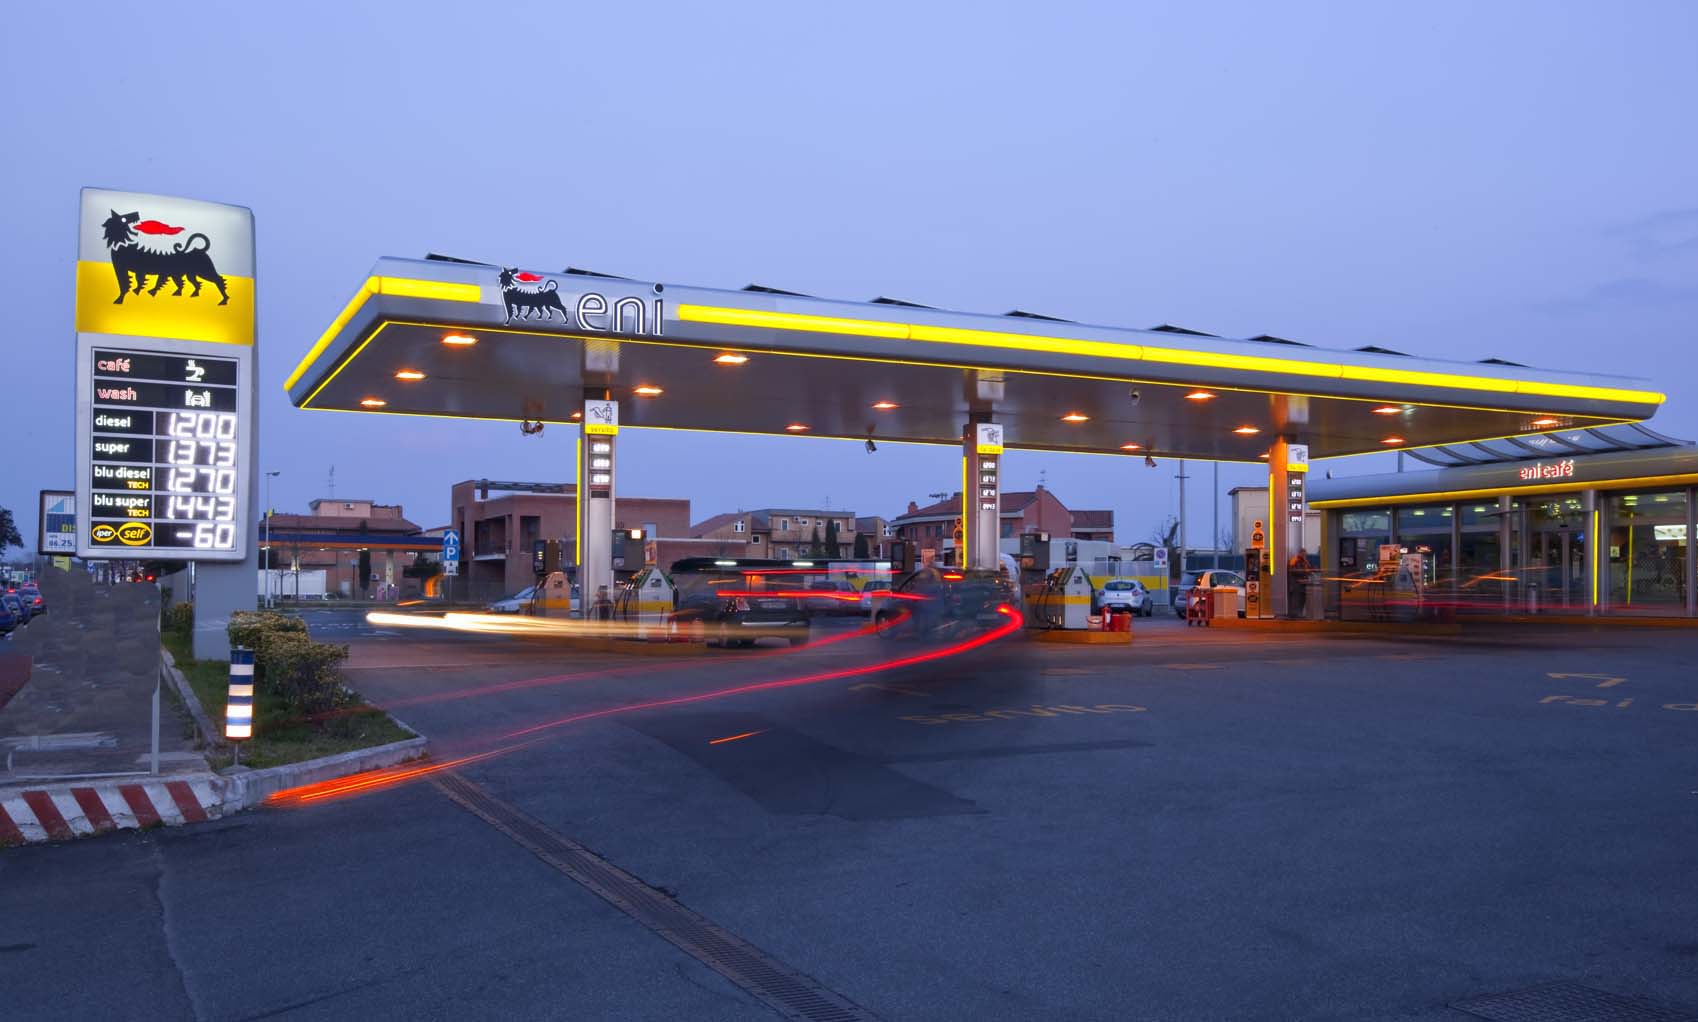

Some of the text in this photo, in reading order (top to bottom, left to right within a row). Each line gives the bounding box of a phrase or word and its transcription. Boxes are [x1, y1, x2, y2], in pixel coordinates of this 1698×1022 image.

[575, 282, 665, 336] eni
[97, 358, 131, 373] café
[97, 386, 137, 401] wash
[95, 414, 131, 428] diesel
[95, 442, 130, 455] super
[94, 465, 150, 479] blu diesel
[1519, 459, 1575, 480] eni café
[127, 480, 149, 489] TECH
[94, 494, 150, 509] blu super
[127, 508, 150, 517] TECH
[96, 528, 147, 539] iper self
[446, 546, 457, 560] P
